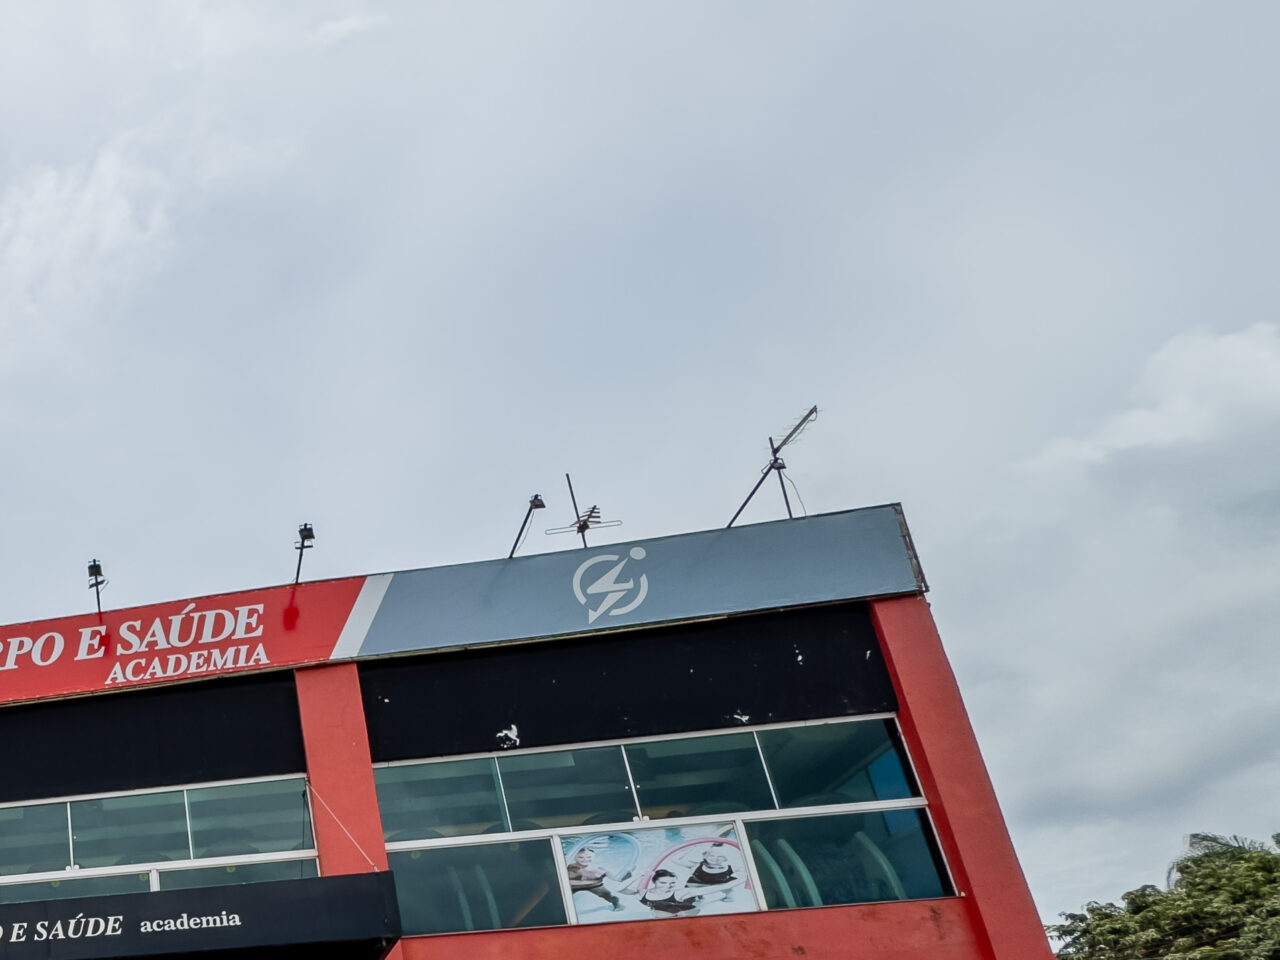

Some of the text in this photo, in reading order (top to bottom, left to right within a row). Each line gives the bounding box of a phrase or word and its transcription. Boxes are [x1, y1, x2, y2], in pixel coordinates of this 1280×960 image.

[74, 625, 107, 661] E
[116, 602, 265, 656] SAÚDE
[104, 643, 271, 685] ACADEMIA
[9, 922, 28, 943] E
[33, 912, 124, 941] SAÚDE
[140, 910, 242, 933] academia
